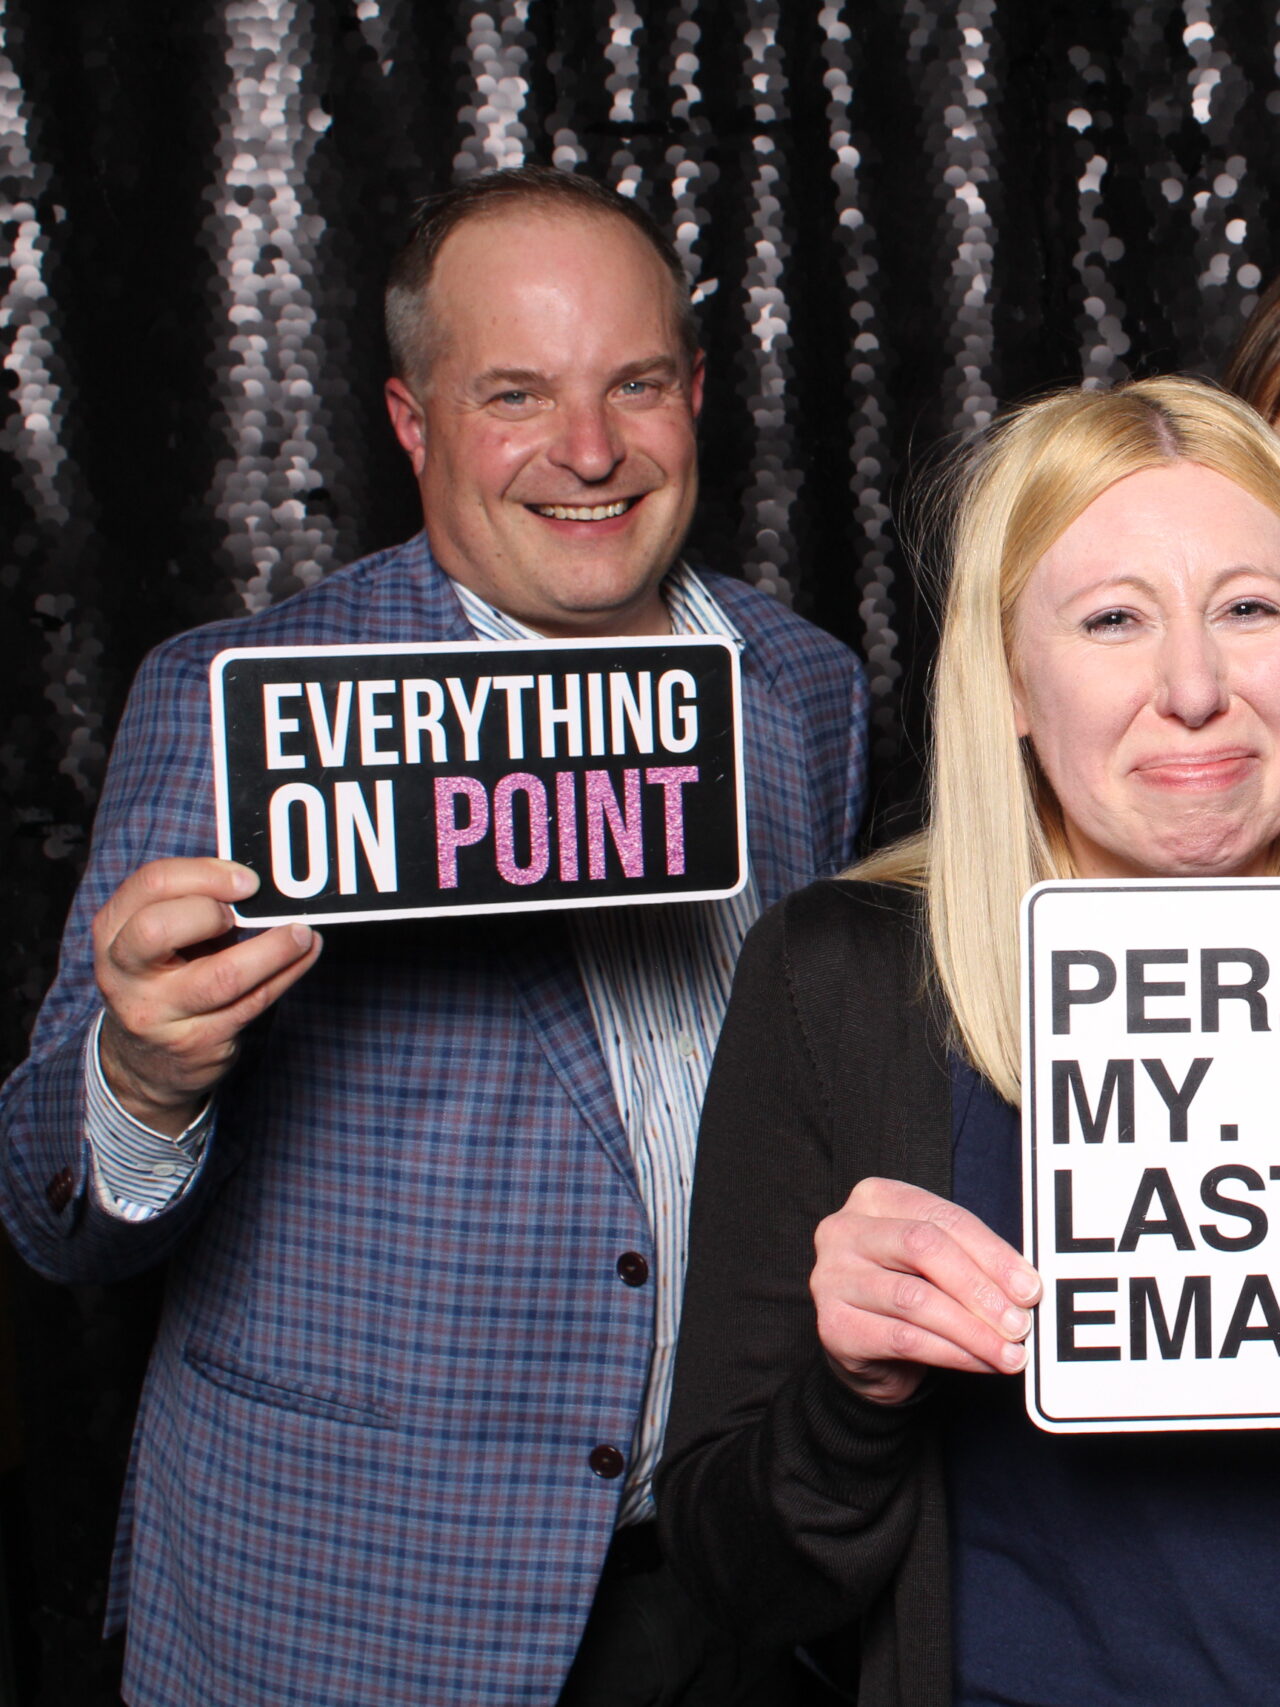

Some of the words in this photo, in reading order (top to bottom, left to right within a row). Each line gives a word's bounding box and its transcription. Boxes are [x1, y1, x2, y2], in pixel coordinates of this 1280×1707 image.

[263, 669, 698, 770] EVERYTHING
[269, 779, 398, 898] ON
[433, 765, 699, 890] POINT
[1051, 1057, 1239, 1145] MY.
